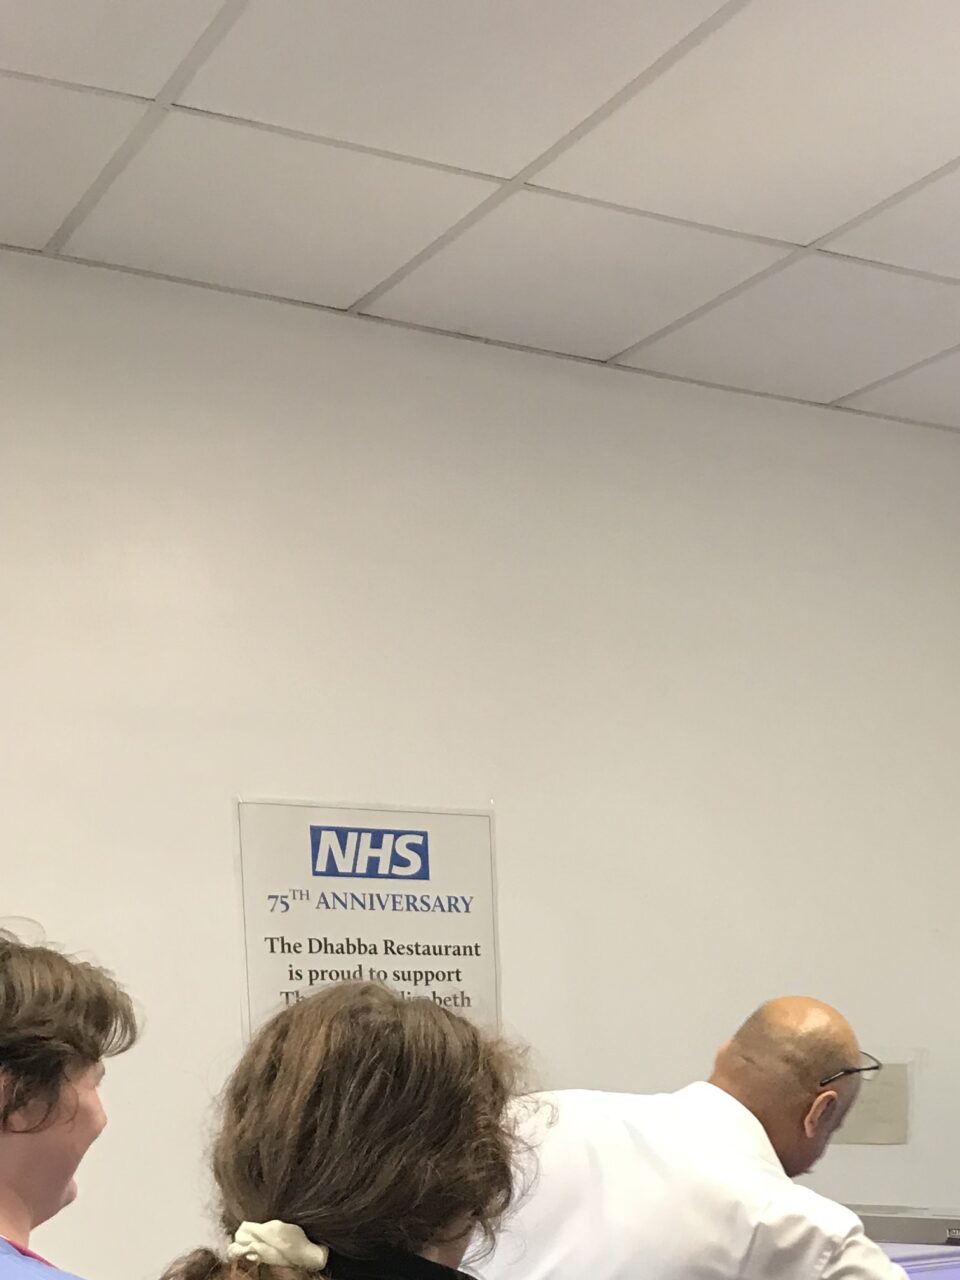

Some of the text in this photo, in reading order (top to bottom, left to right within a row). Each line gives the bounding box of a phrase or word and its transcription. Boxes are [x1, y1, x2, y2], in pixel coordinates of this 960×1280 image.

[314, 830, 425, 876] NHS
[267, 888, 474, 914] 75TH ANNIVERSARY
[264, 935, 482, 957] The Dhabba Restaurant
[288, 964, 463, 987] is proud to support
